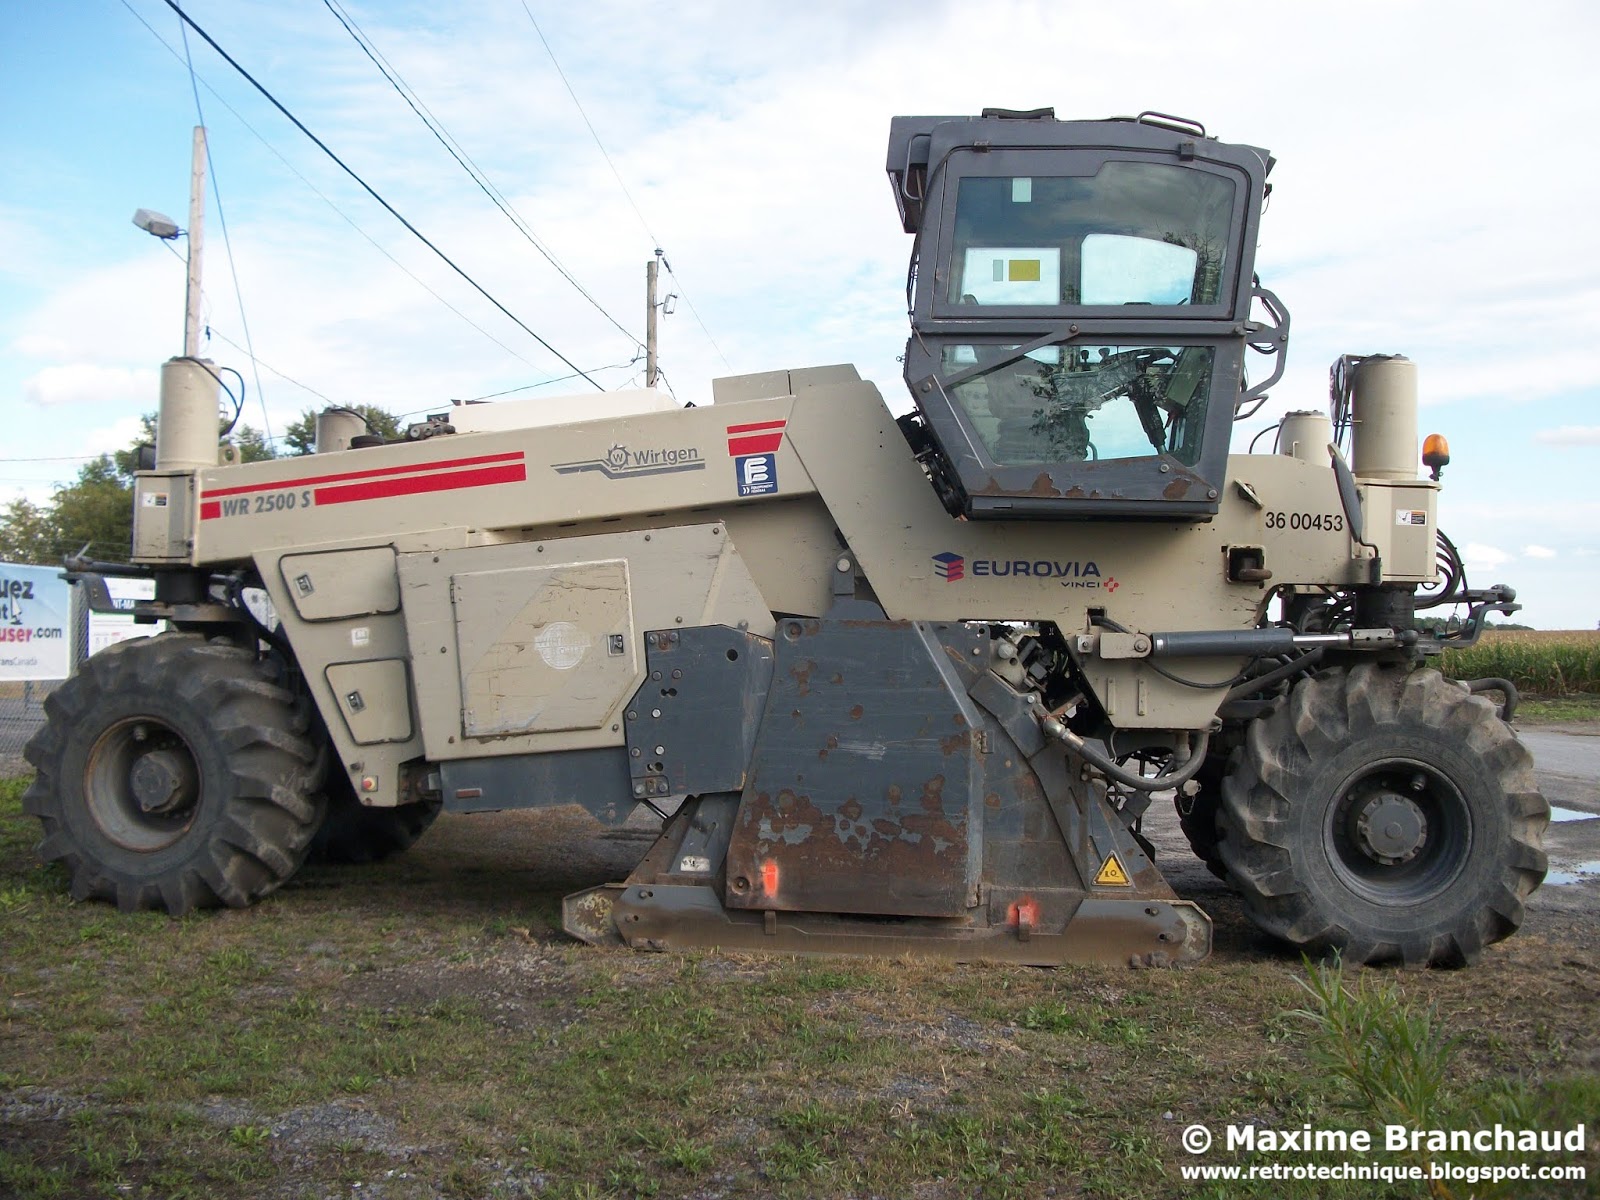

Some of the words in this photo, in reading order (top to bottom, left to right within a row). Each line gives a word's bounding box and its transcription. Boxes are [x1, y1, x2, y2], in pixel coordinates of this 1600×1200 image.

[633, 447, 698, 465] Wirtgen
[223, 498, 250, 517] WR
[255, 492, 296, 513] 2500
[301, 490, 310, 508] S
[1265, 511, 1286, 529] 36
[1290, 512, 1343, 532] 00453
[972, 560, 1101, 577] EUROVIA
